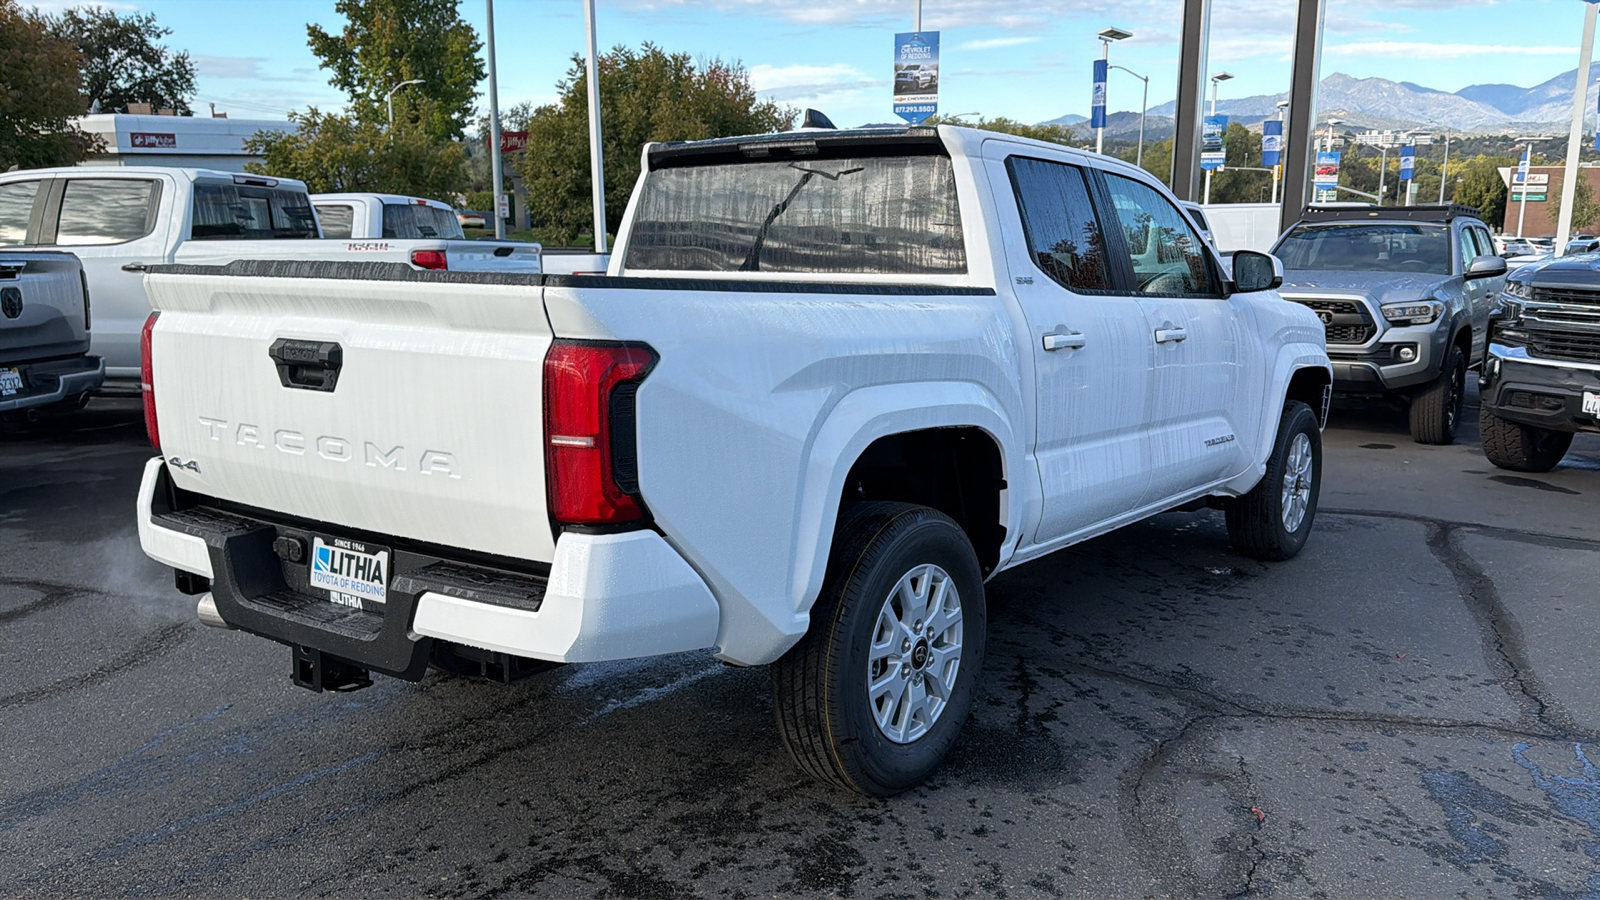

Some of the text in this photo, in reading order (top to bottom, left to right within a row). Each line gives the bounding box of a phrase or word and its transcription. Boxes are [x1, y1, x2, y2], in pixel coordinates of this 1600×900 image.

[901, 46, 931, 54] CHEVROLET
[908, 52, 931, 60] REDDING
[199, 416, 461, 479] TACOMA
[334, 538, 365, 552] SINCE 1946
[329, 549, 384, 585] LITHIA
[314, 571, 385, 597] TOYOTA OF REDDING
